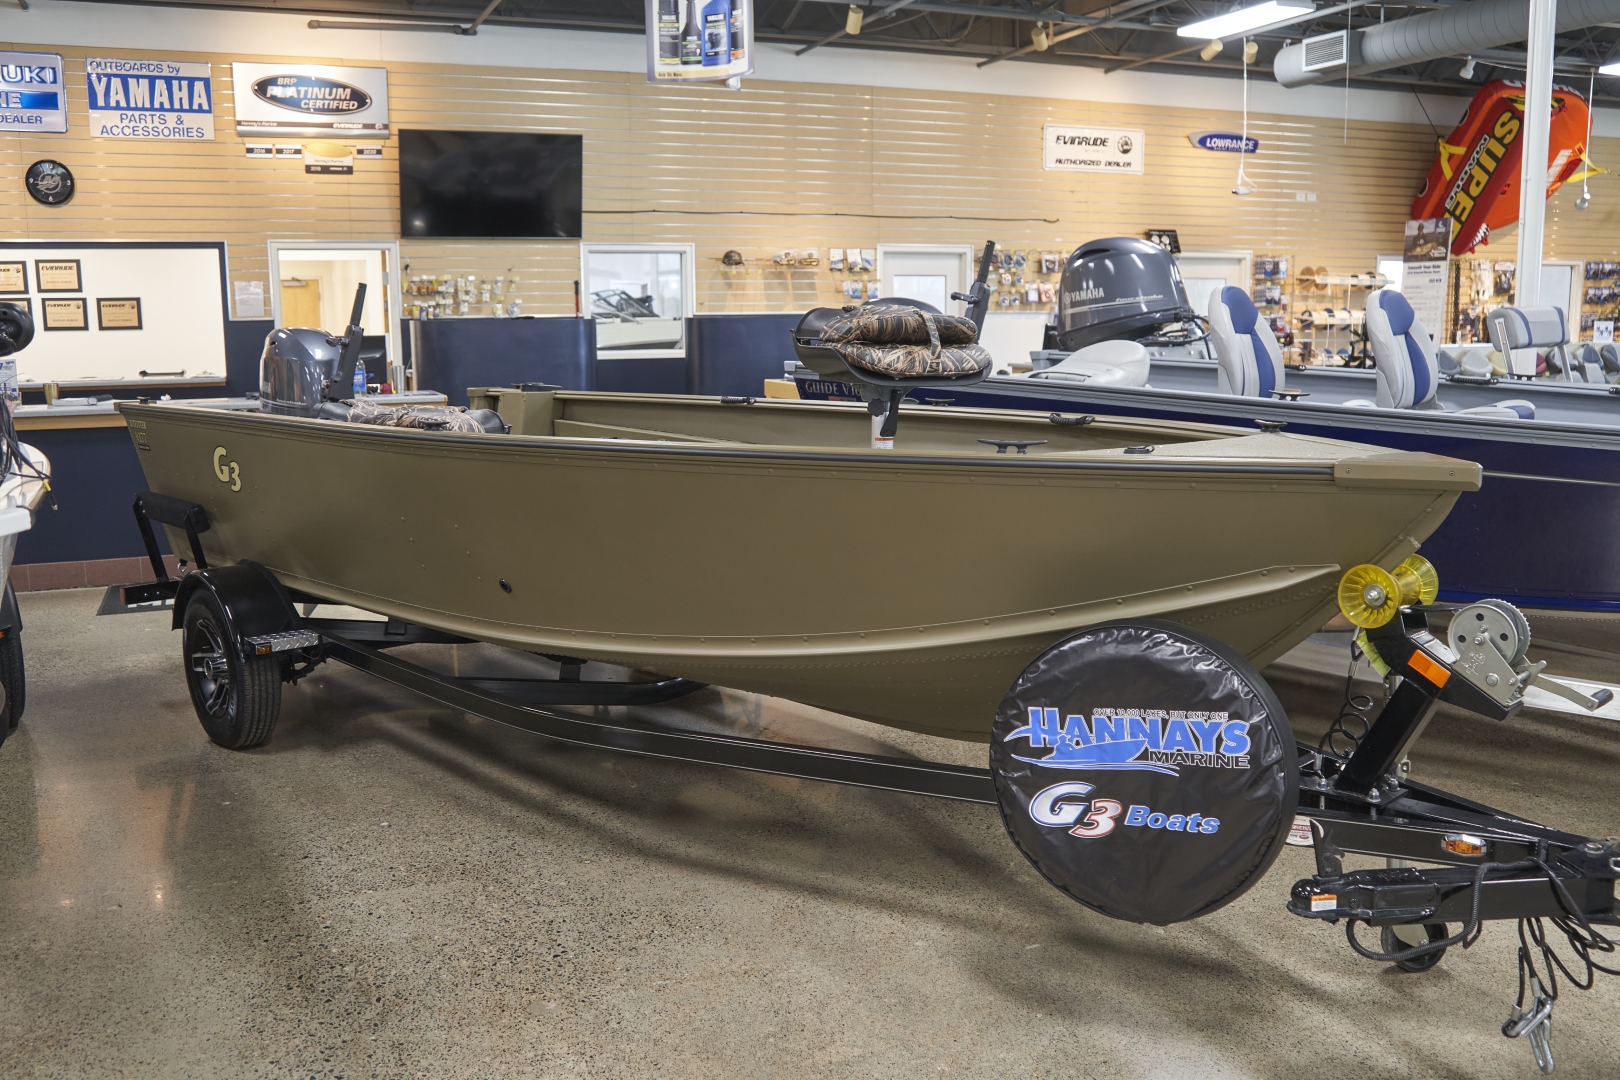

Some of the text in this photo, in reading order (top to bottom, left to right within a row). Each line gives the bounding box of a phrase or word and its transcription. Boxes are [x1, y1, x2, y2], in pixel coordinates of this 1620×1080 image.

[89, 60, 181, 75] OUTBOARDS by
[277, 77, 297, 85] BRP
[90, 76, 210, 110] YAMAHA
[266, 86, 352, 100] PLATINUM
[301, 100, 358, 110] CERTIFIED
[119, 113, 184, 125] PARTS &
[100, 125, 205, 138] ACCESSORIES
[1055, 135, 1110, 147] EVINRUDE
[1206, 137, 1255, 150] LOWRANCE
[1055, 158, 1132, 168] AUTHORIZED DEALER
[1071, 288, 1105, 301] YAMAHA
[805, 381, 840, 395] GUIDE
[213, 446, 242, 493] G3
[1092, 708, 1116, 717] OVER
[1170, 711, 1187, 720] BUT
[1187, 711, 1210, 720] ONLY
[1210, 712, 1229, 721] ONE
[1003, 707, 1252, 755] HANNAYS
[1149, 750, 1251, 769] MARINE
[1029, 781, 1221, 838] G3 Boats
